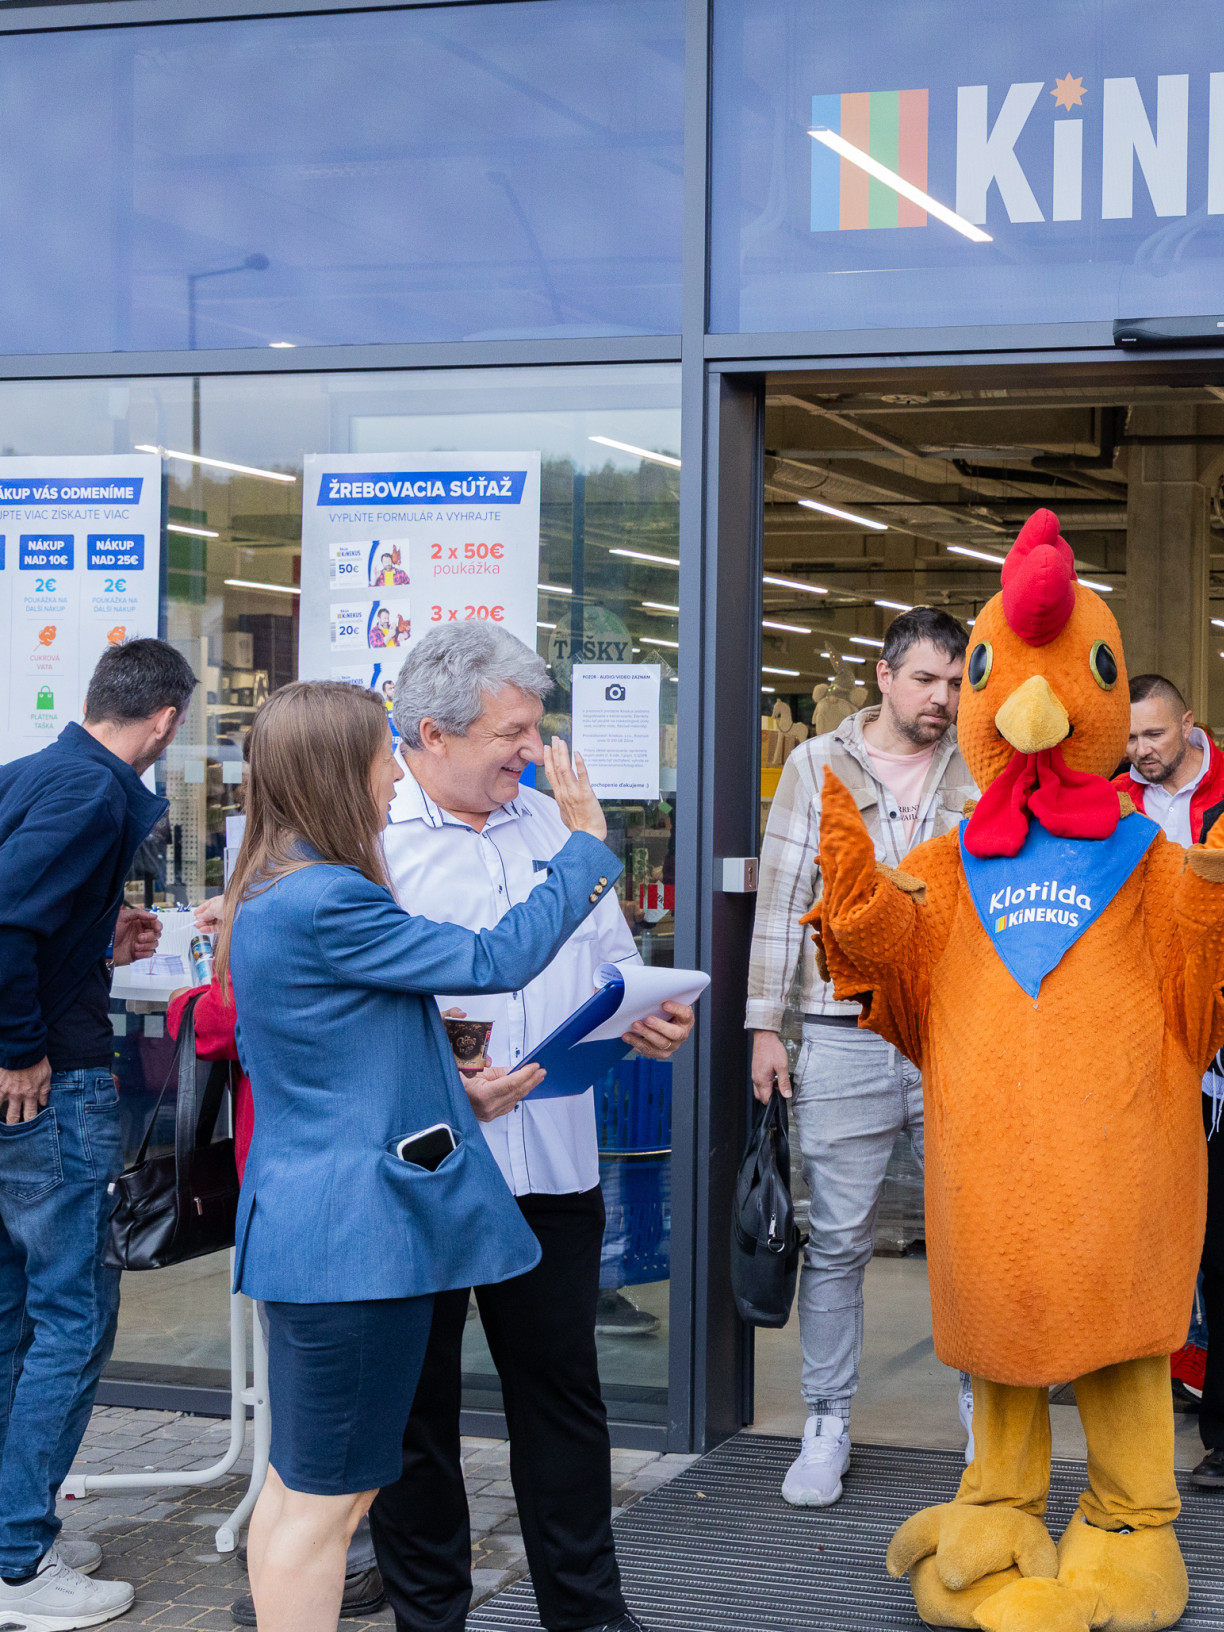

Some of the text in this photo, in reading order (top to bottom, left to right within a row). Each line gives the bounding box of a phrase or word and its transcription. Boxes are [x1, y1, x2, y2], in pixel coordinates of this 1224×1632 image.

[32, 484, 59, 500] VÁS
[60, 484, 134, 499] ODMENÍME
[328, 476, 512, 499] ŽREBOVACIA SÚŤAŽ
[0, 507, 130, 520] PTE VIAC ZÍSKAJTE VIAC
[328, 510, 501, 523] VYPLŇTE FORMULÁR A VYHRAJTE
[28, 538, 65, 551] NÁKUP
[96, 538, 134, 551] NÁKUP
[430, 543, 504, 560] 2 x 50€
[24, 555, 68, 565] NAD 10€
[92, 555, 139, 565] NAD 25€
[433, 561, 500, 578] poukážka
[35, 578, 57, 592] 2€
[104, 578, 127, 592] 2€
[430, 605, 504, 622] 3 x 20€
[554, 635, 629, 661] TŠKY
[989, 880, 1092, 914] Klotilda
